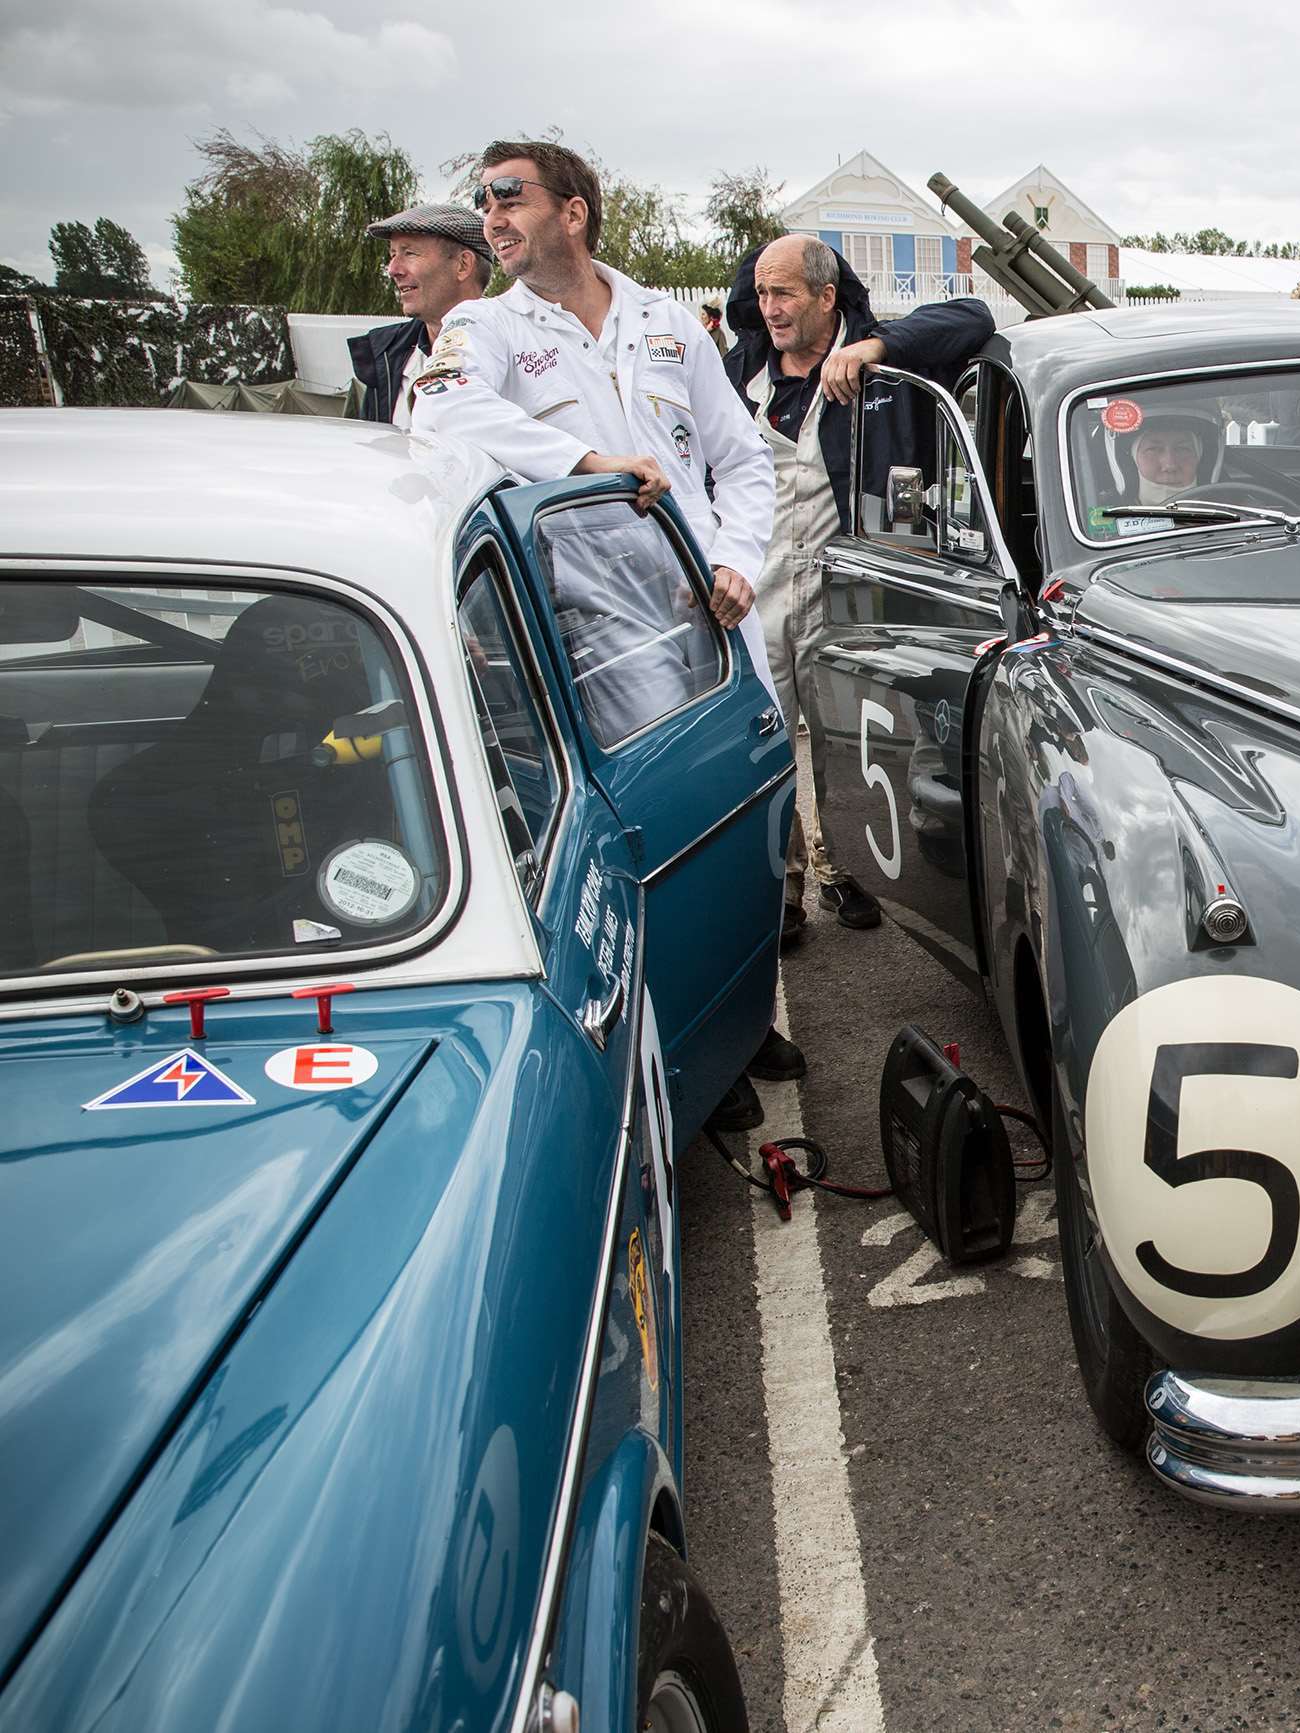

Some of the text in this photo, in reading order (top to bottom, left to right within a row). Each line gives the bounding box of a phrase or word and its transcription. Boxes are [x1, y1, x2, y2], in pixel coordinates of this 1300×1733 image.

[275, 797, 306, 872] OMP
[861, 698, 902, 881] 5
[293, 1047, 354, 1084] E
[1135, 1042, 1300, 1299] 5
